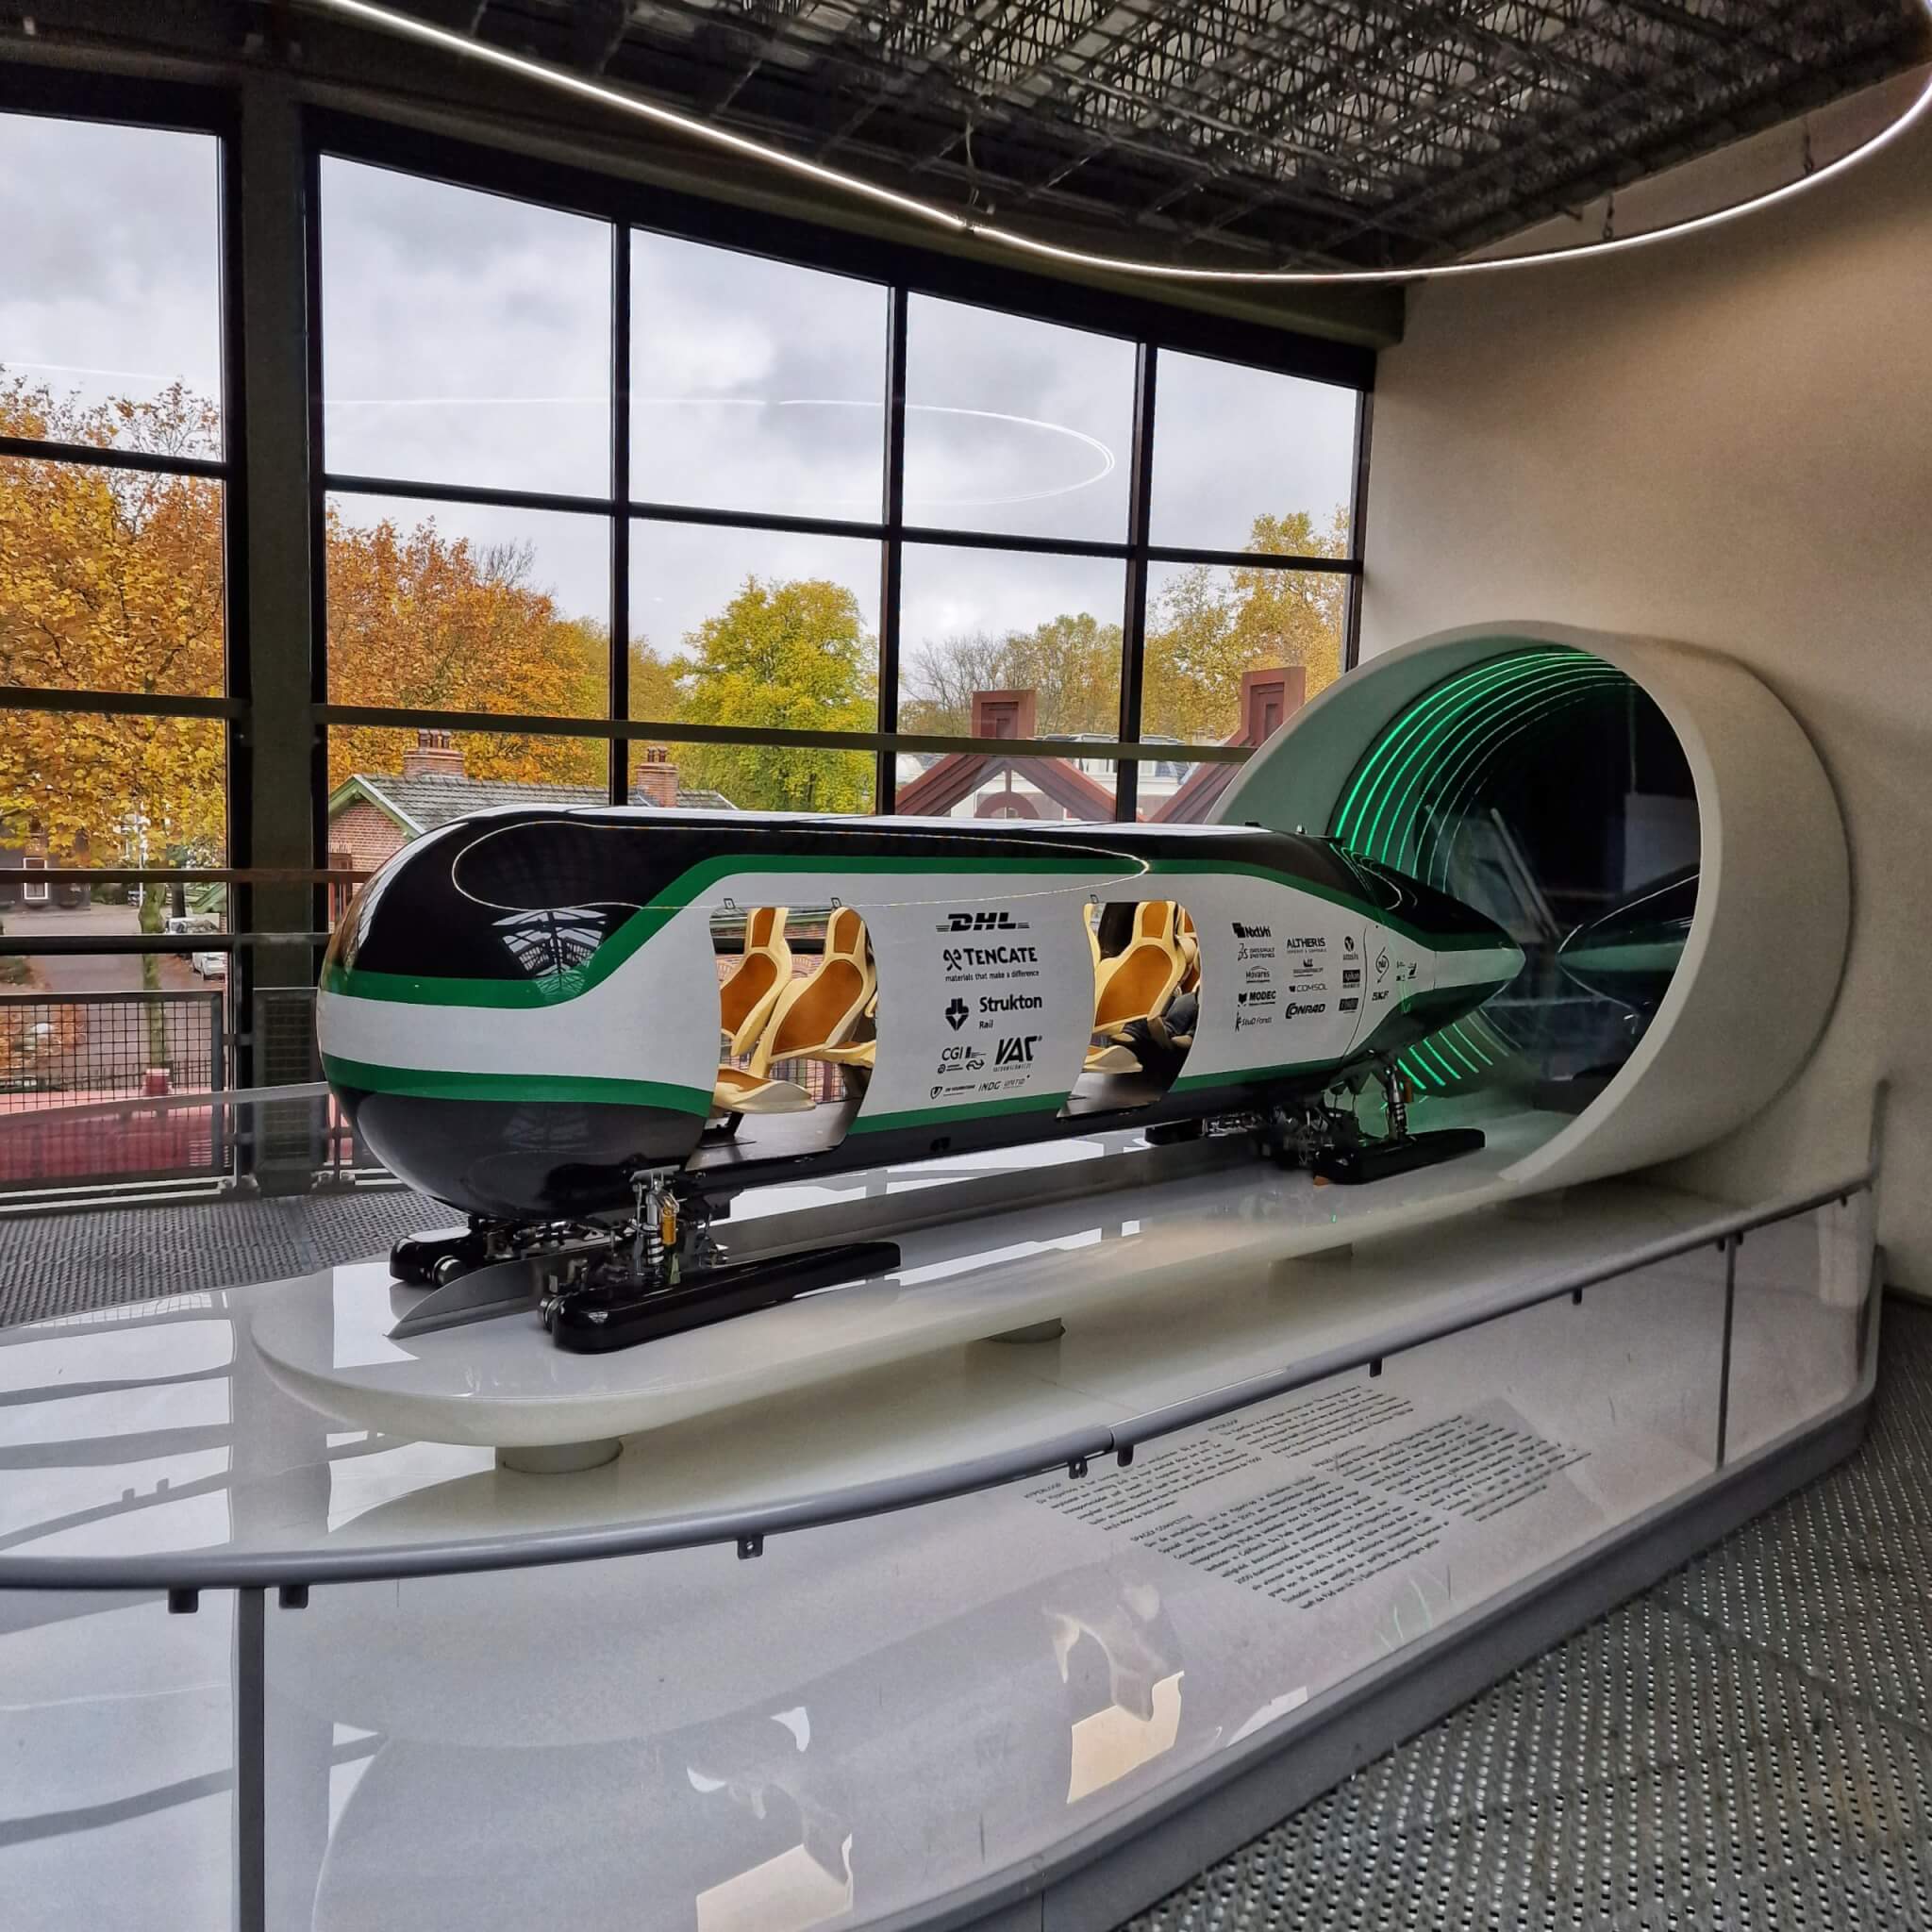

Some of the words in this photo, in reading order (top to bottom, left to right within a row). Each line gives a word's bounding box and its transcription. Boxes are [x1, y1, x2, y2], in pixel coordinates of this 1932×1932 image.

[948, 912, 1016, 932] DHL
[1287, 937, 1325, 948] ALTHERIS
[945, 974, 974, 982] materials
[1011, 970, 1040, 978] difference
[1297, 983, 1327, 992] COMSOL
[1250, 991, 1275, 1001] MODEC
[1372, 991, 1389, 1001] SKF
[979, 993, 1042, 1012] Strukton
[979, 1019, 993, 1029] Rail
[941, 1046, 963, 1060] CGI
[978, 1080, 1001, 1091] INDG
